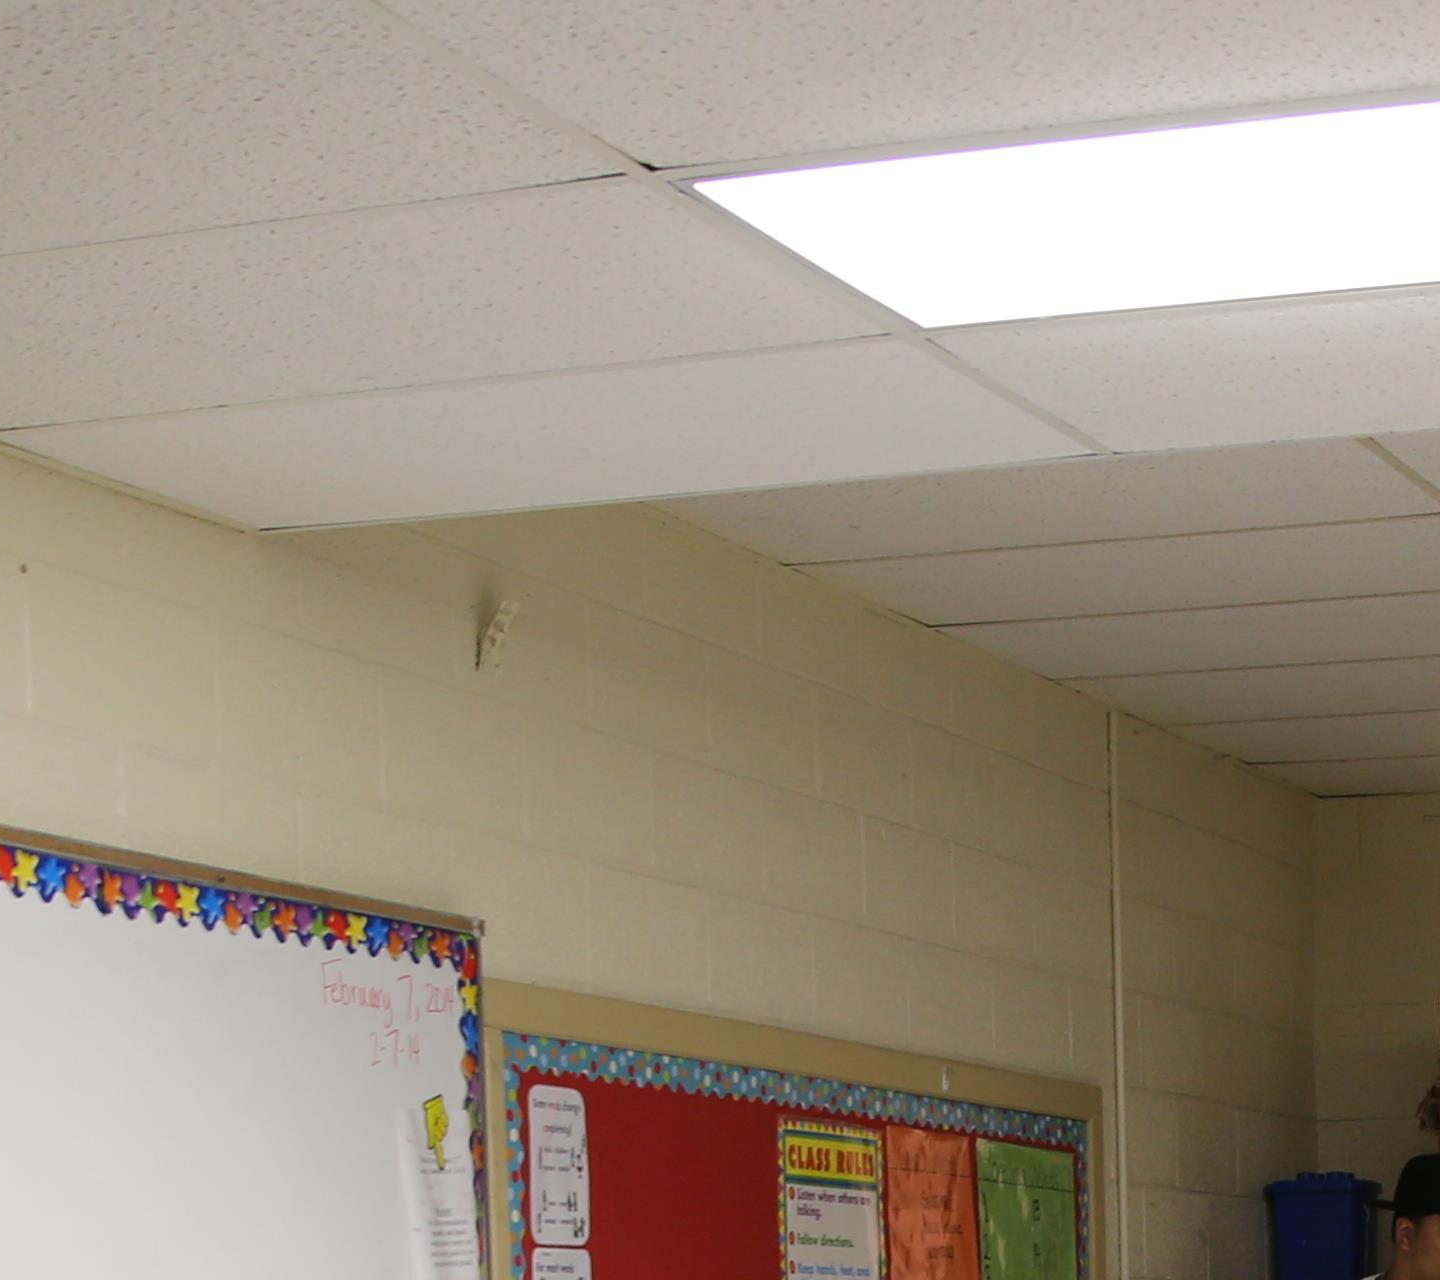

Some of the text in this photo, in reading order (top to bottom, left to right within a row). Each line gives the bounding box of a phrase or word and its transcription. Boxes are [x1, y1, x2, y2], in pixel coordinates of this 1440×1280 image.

[320, 957, 456, 1029] February 7, 2014
[788, 1144, 875, 1177] CLASS RULES
